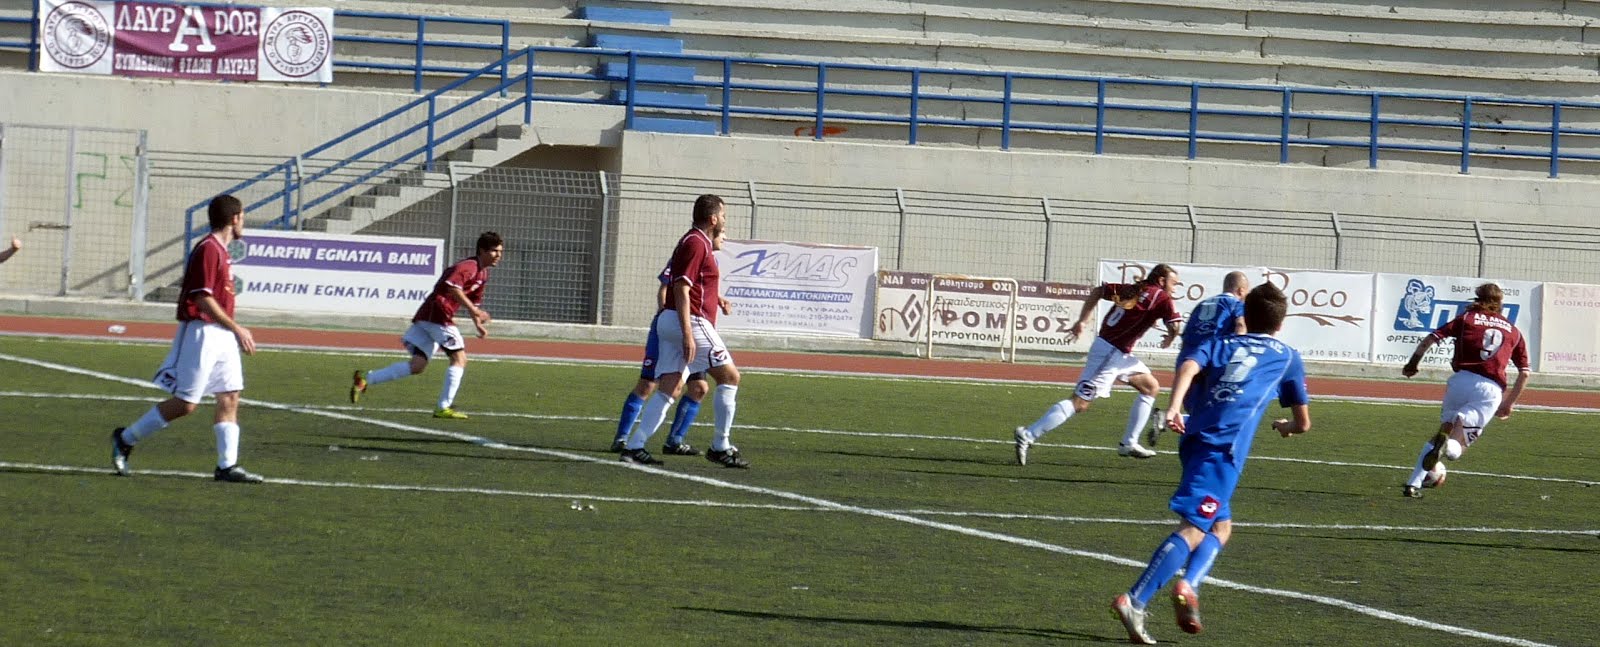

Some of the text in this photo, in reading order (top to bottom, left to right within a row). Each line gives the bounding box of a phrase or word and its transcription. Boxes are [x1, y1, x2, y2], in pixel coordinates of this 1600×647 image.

[248, 243, 432, 266] MARFIN EGNATIA BANK
[247, 281, 428, 301] MARFIN EGNATIA BANK
[883, 275, 904, 285] ΝΑΙ
[992, 281, 1012, 292] ΟΧΙ
[1021, 285, 1037, 293] στα
[1045, 286, 1091, 297] Ναρκωτικά
[1451, 285, 1472, 294] ΒΑΡΗ
[800, 306, 849, 314] ΓΛΥΦΑΔΑ
[942, 310, 1070, 333] ΡΟΜΒΟΣ
[931, 330, 1070, 346] ΡΓΥΡΟΥΠΟΛΗ ΛΙΟΥΠΟΛΗ
[1479, 328, 1503, 361] 9
